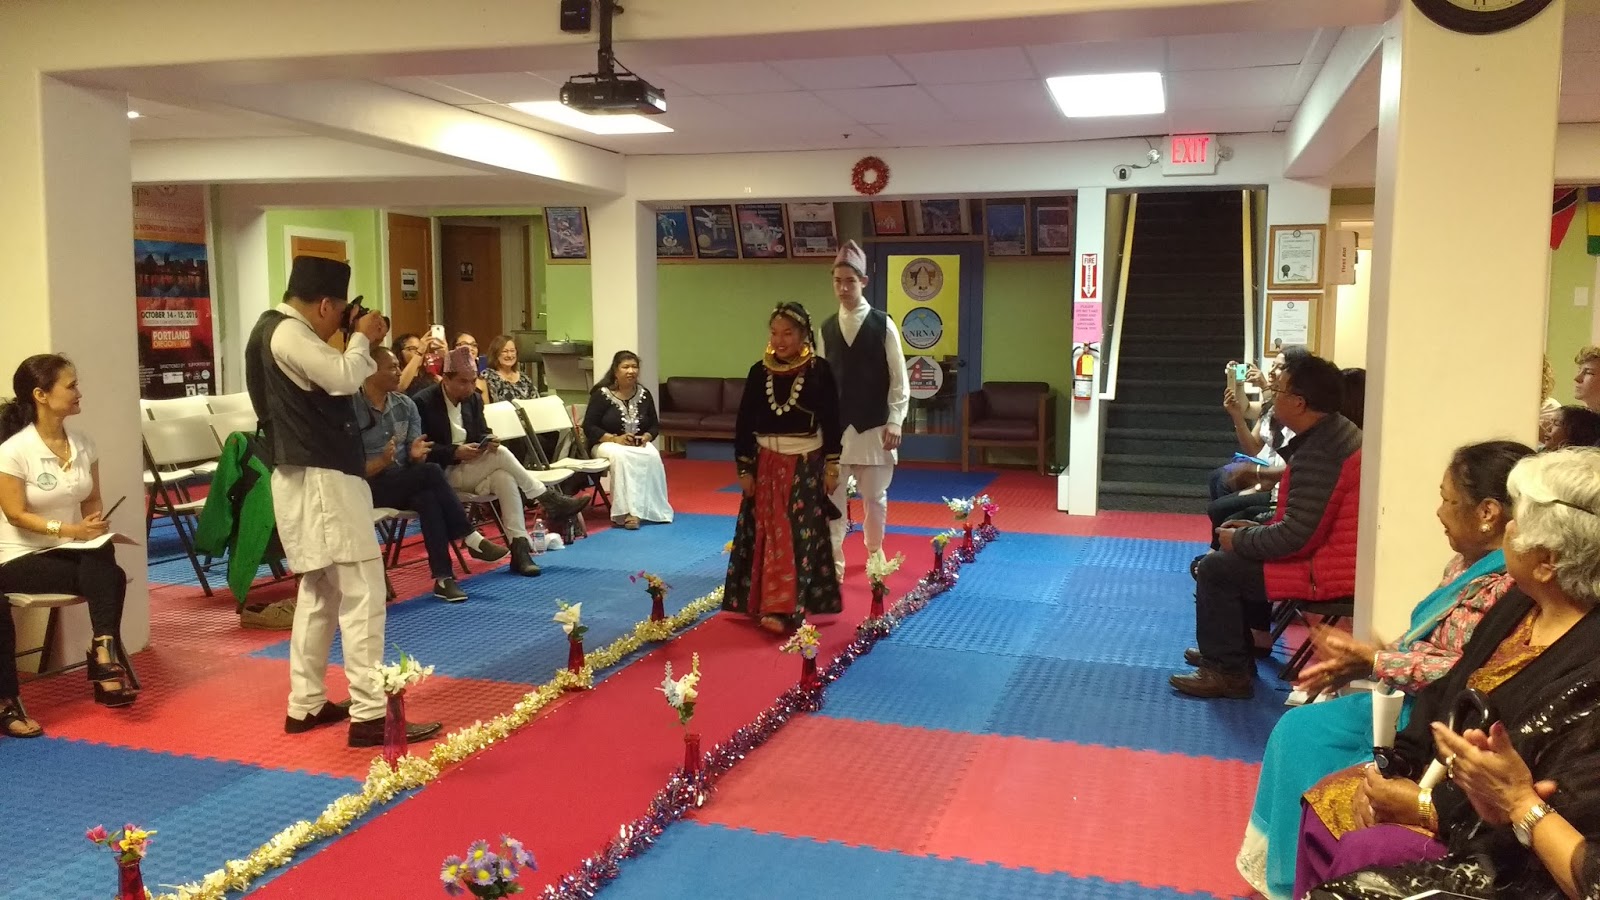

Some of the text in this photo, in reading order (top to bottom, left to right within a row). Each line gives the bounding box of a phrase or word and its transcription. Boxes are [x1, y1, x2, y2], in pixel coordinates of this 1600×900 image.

[1172, 138, 1209, 163] EXIT
[141, 311, 165, 319] OCTOBER
[167, 311, 173, 319] 14
[153, 330, 190, 340] PORTLAND
